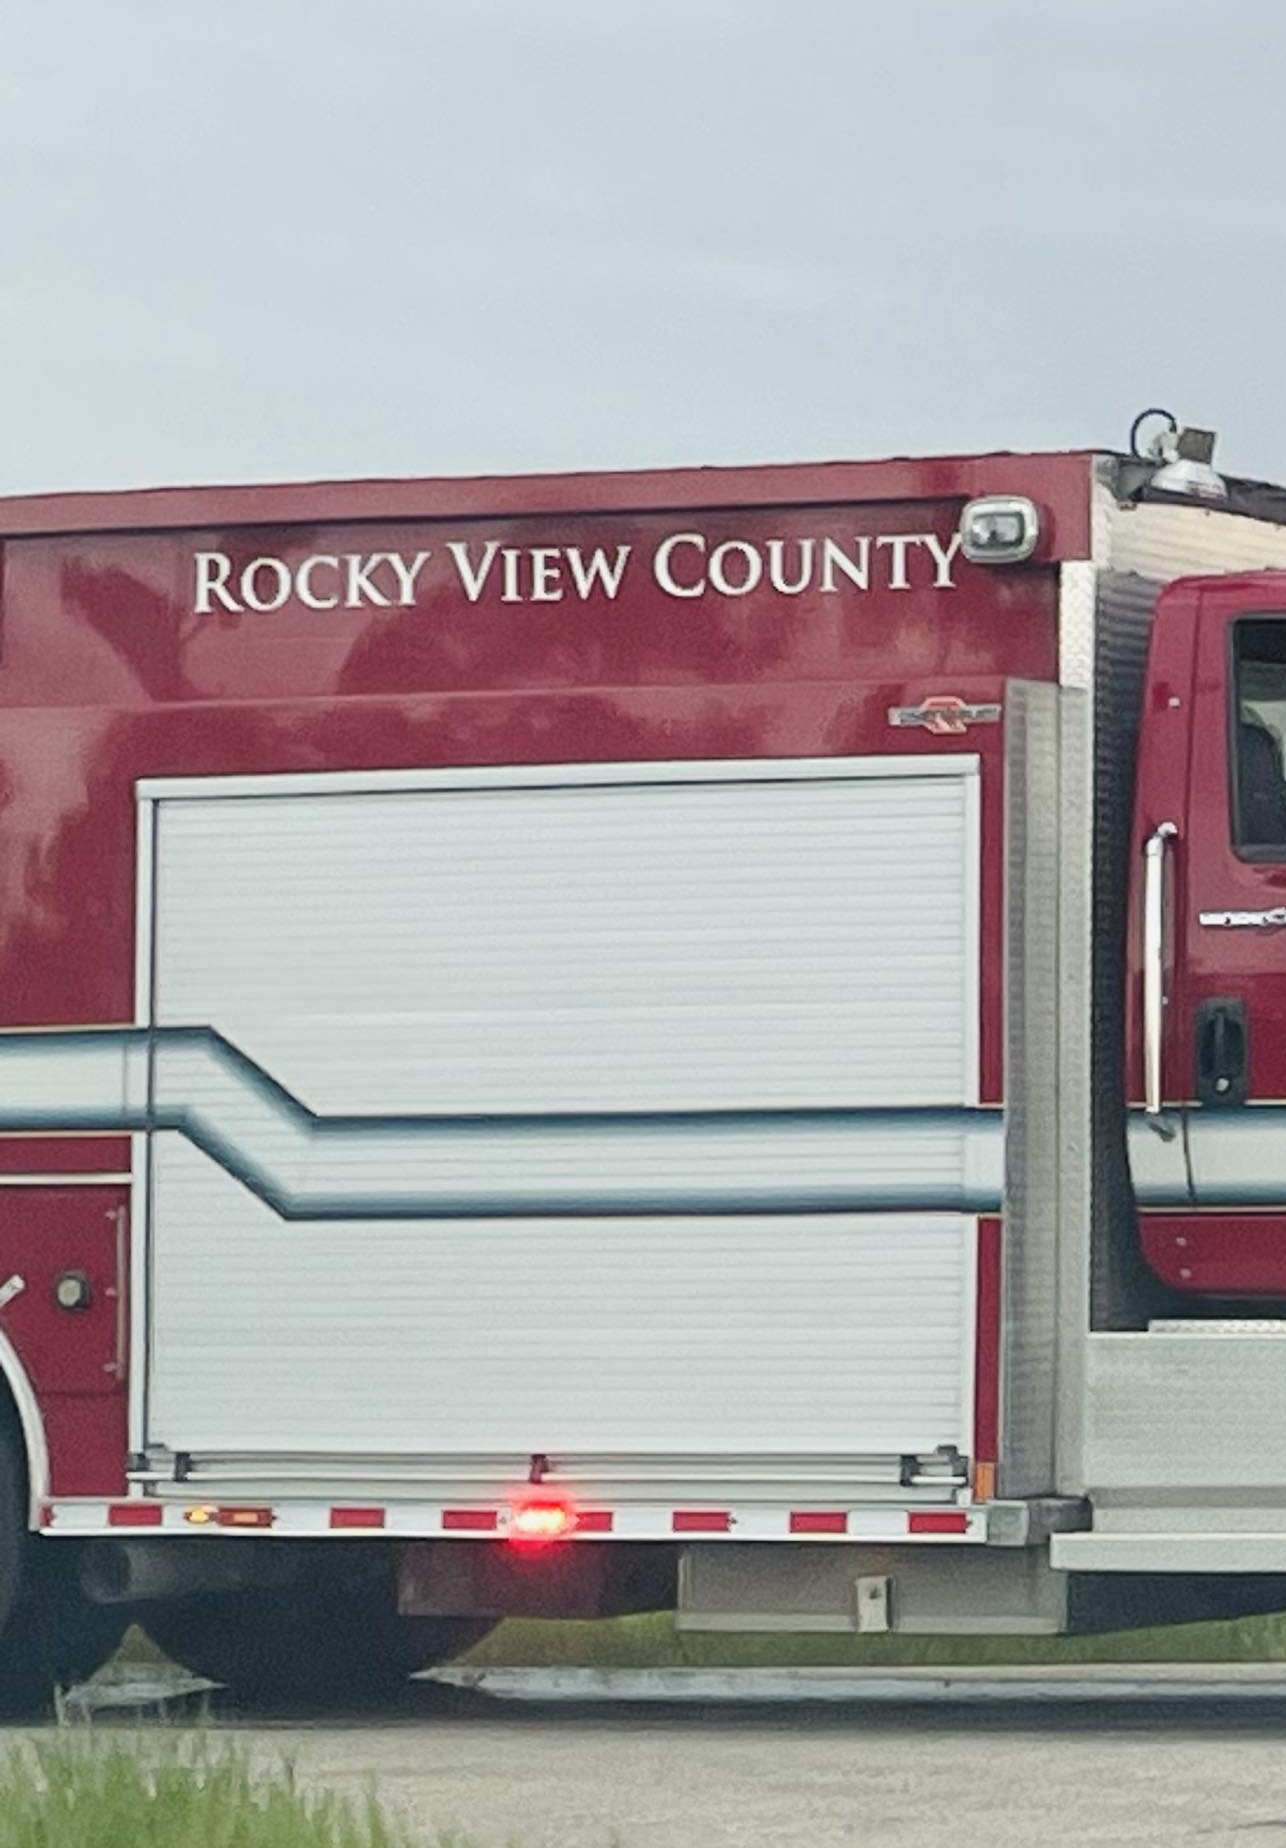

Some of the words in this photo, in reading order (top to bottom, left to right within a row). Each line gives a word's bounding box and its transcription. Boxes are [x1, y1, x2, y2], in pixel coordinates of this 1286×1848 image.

[194, 551, 431, 614] ROCKY
[446, 541, 631, 601] VIEW
[653, 533, 962, 597] COUNTY
